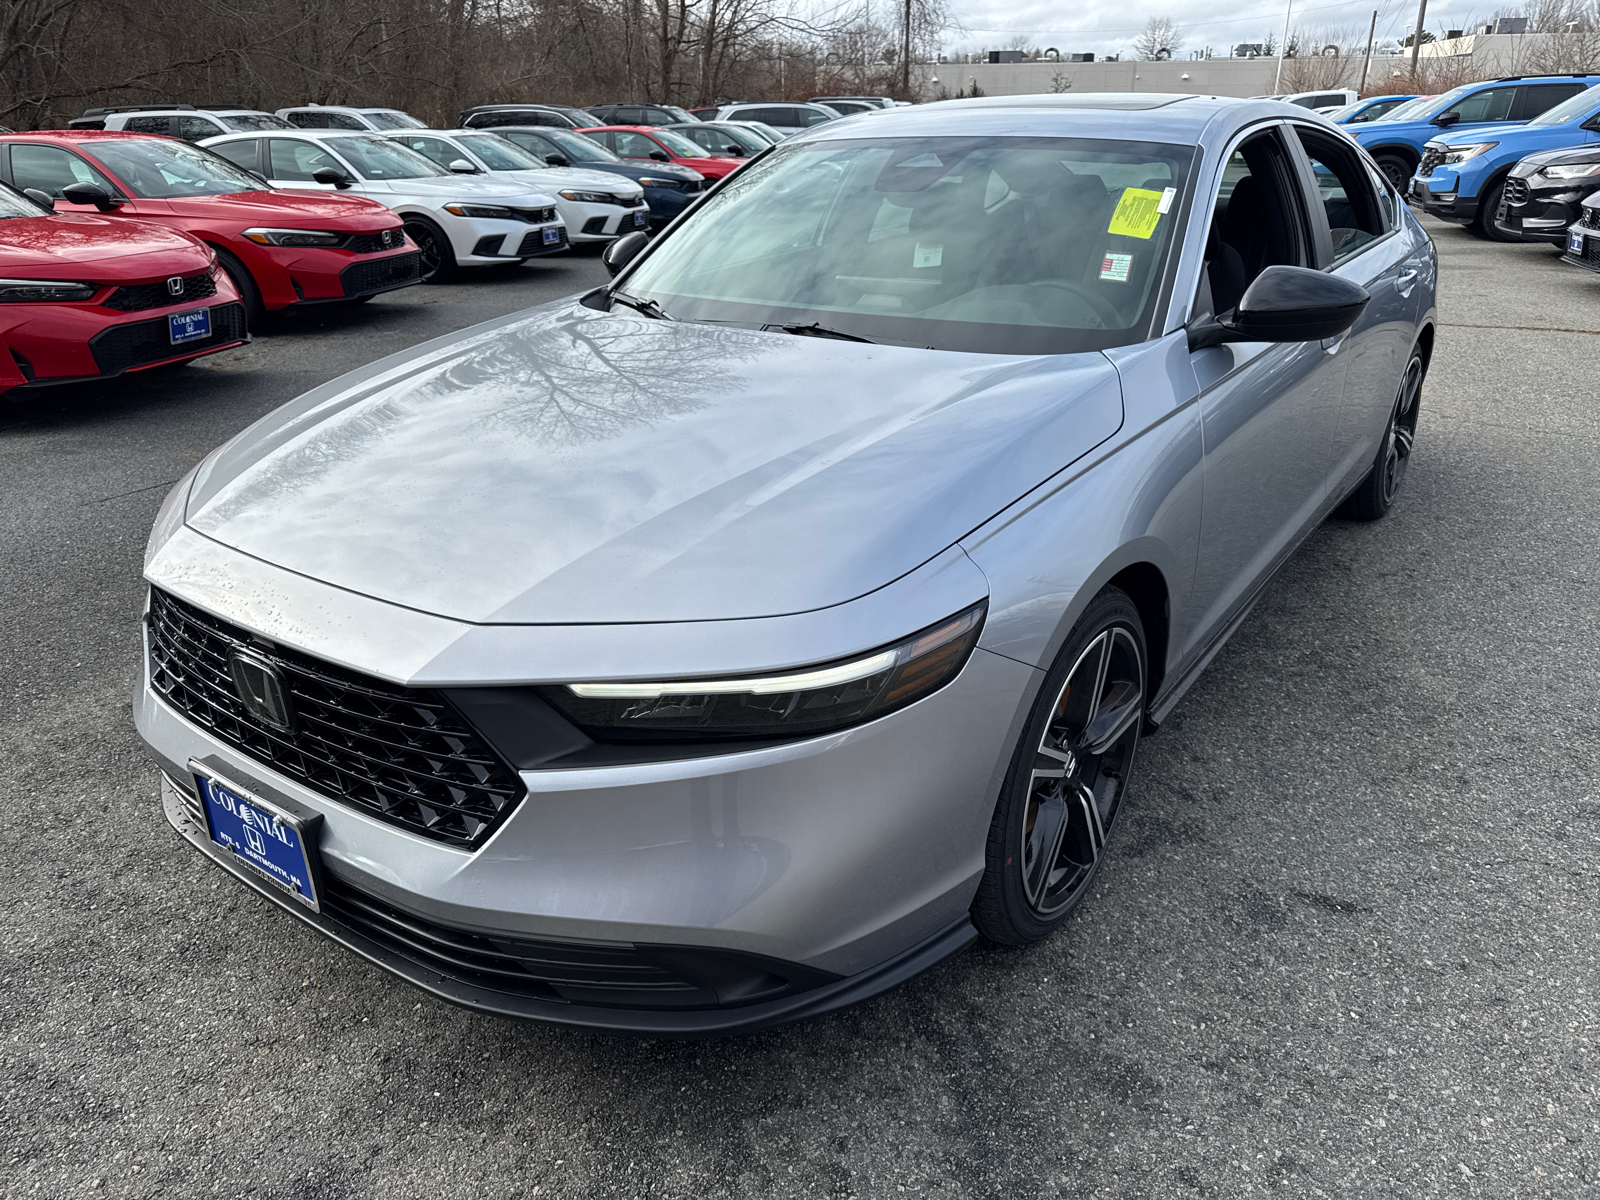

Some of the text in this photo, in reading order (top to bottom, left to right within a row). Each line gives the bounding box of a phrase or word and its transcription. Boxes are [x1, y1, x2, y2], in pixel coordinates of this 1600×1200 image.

[208, 784, 294, 848] COLONIAL
[244, 846, 290, 880] DARTMOUTH,
[290, 874, 302, 888] MA
